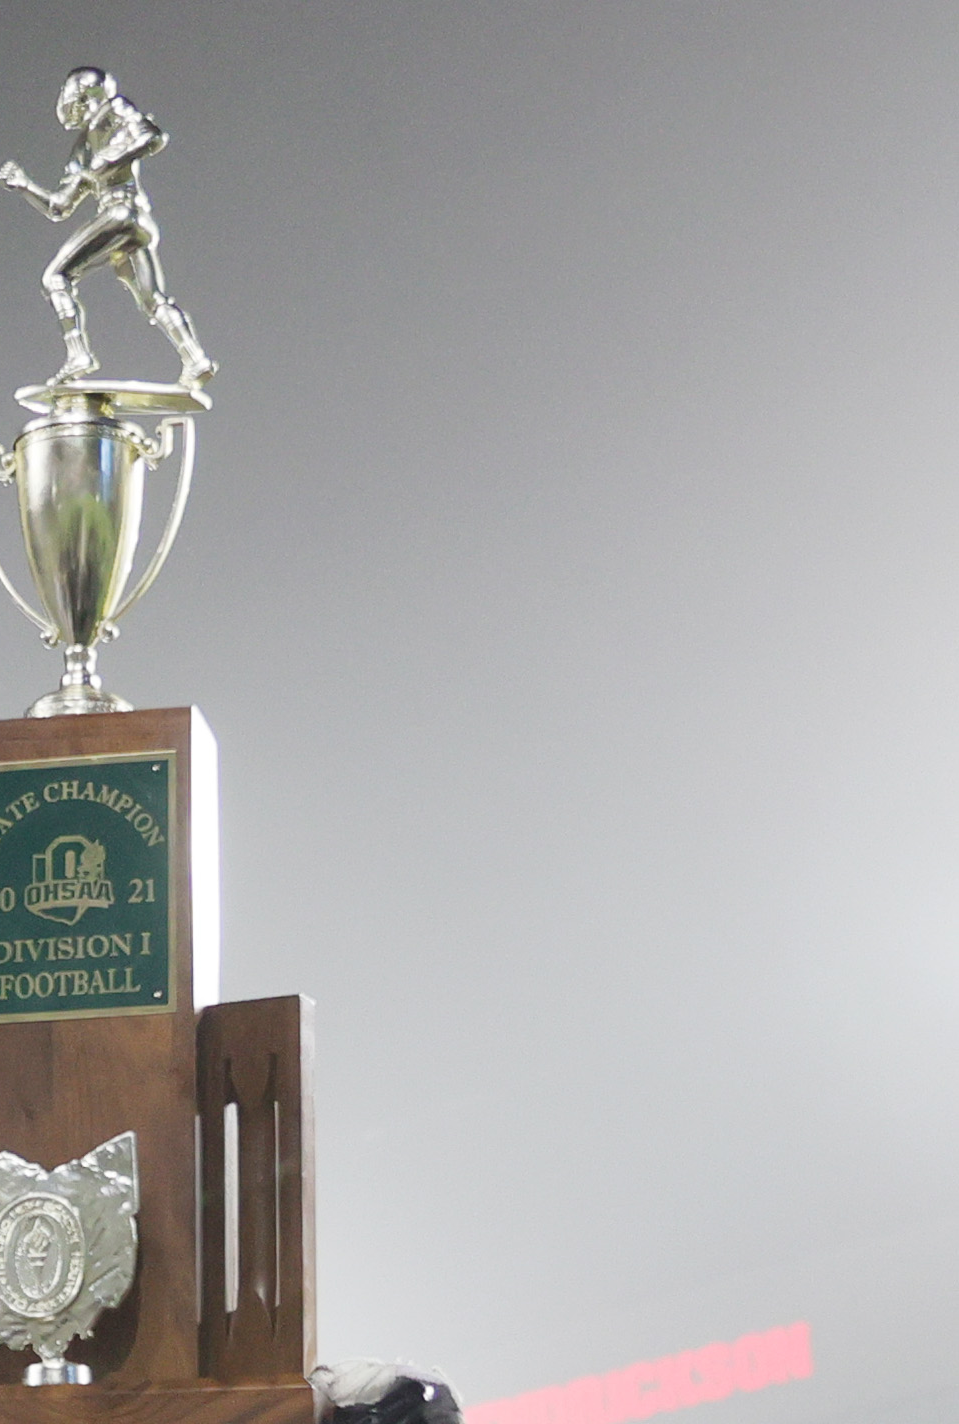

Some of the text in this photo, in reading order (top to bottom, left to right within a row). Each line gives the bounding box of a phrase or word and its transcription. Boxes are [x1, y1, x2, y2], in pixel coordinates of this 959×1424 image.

[43, 780, 165, 847] CHAMPION
[25, 880, 112, 906] OHSAA
[128, 879, 155, 904] 21
[140, 932, 151, 956] I
